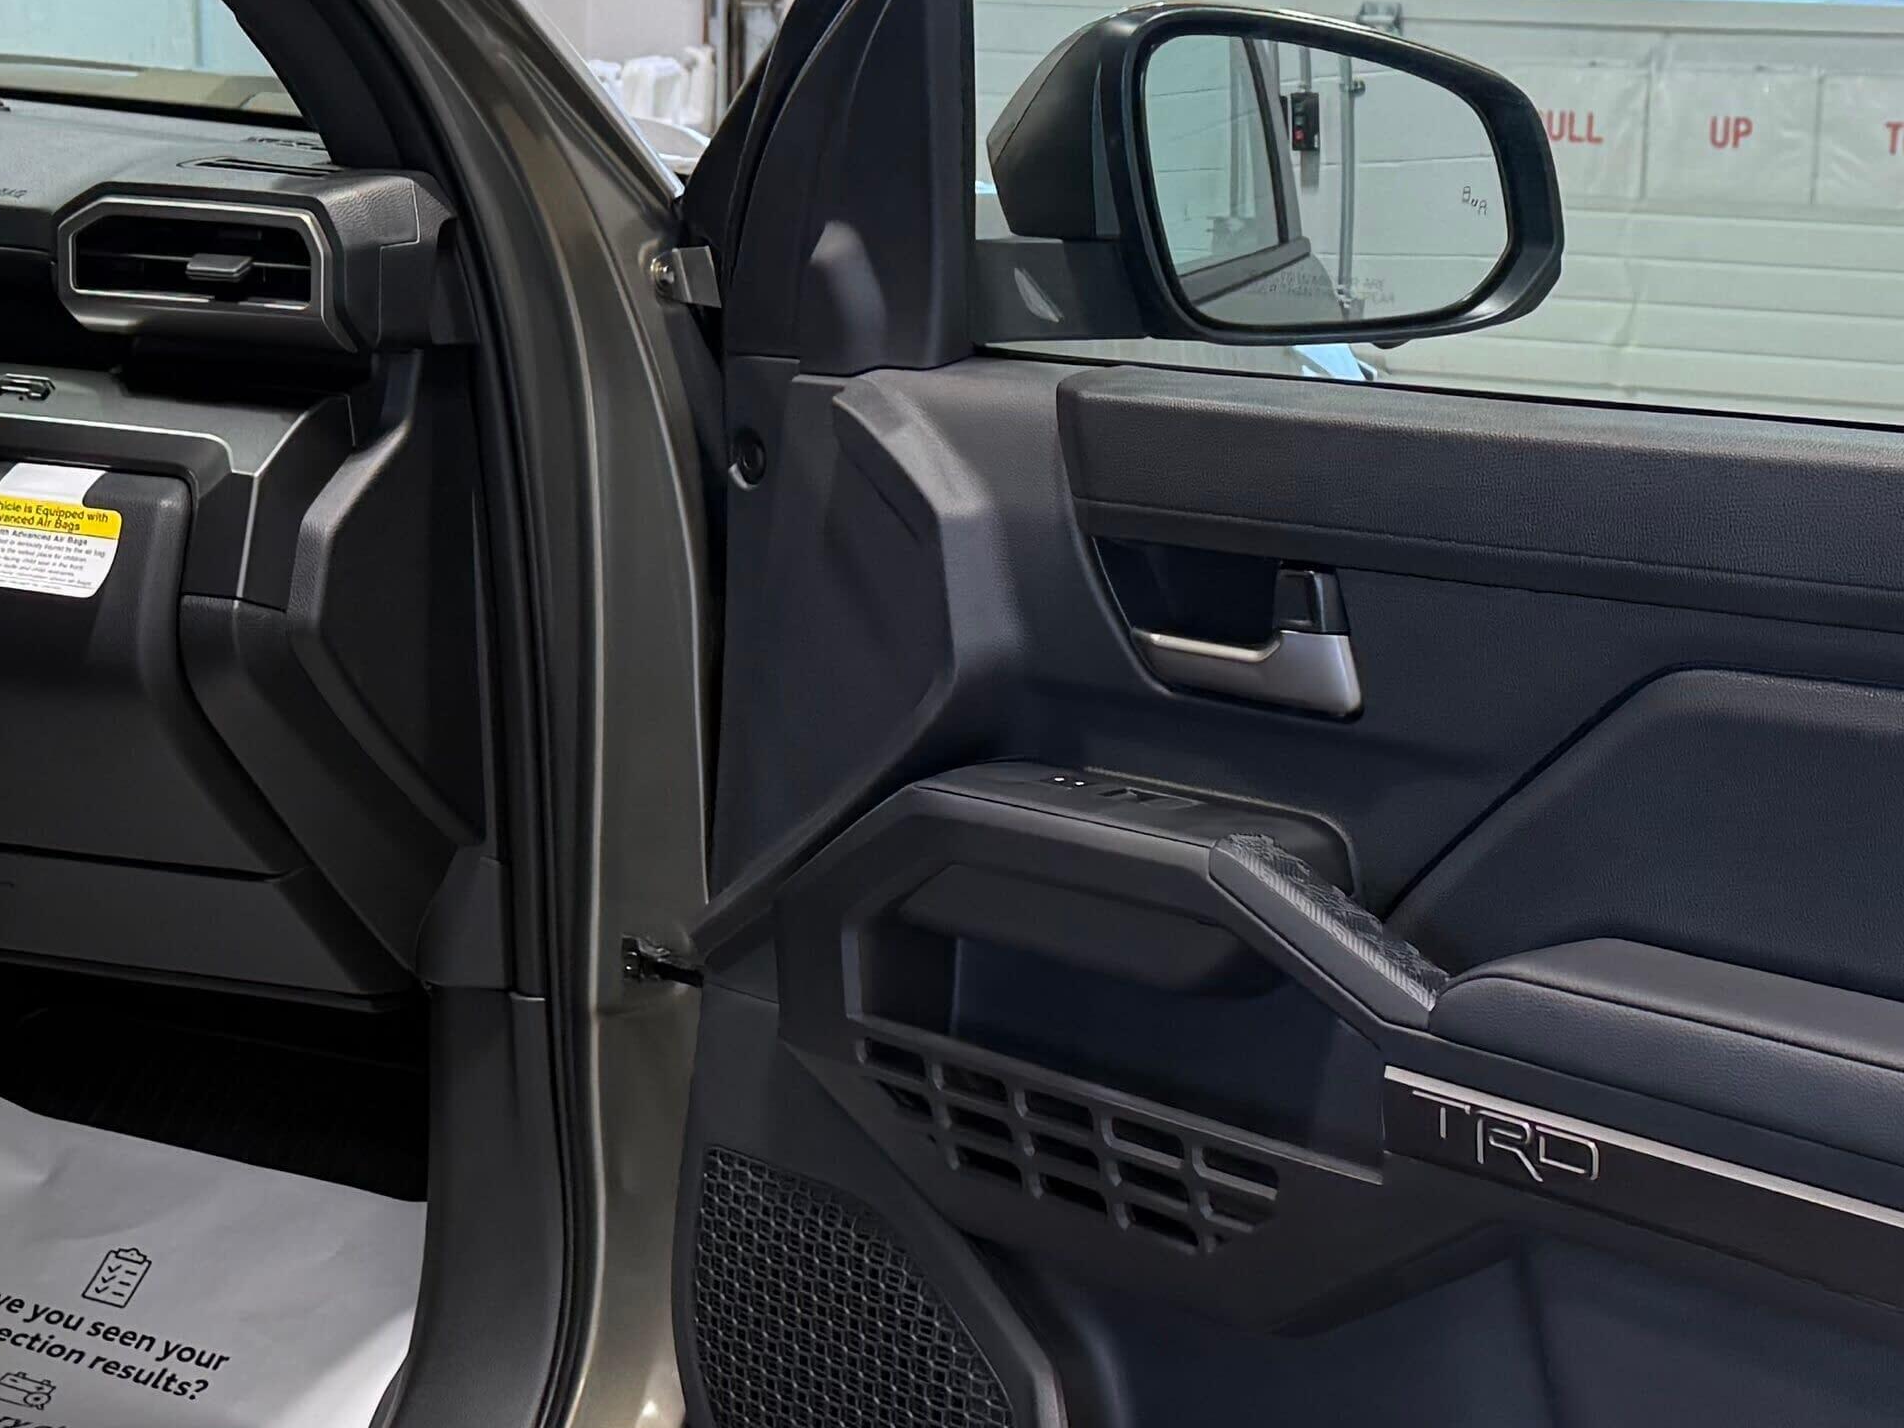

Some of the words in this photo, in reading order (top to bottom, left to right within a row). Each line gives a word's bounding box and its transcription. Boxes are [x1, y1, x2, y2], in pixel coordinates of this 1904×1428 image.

[1540, 110, 1604, 145] ULL
[1709, 115, 1753, 150] UP
[23, 504, 33, 514] is
[36, 505, 85, 521] Equipped
[87, 512, 109, 523] with
[38, 517, 53, 528] Air
[54, 519, 81, 533] Bags
[1412, 1090, 1600, 1182] TRD
[22, 1303, 85, 1332] you
[86, 1320, 156, 1353] seen
[154, 1339, 231, 1371] your
[87, 1354, 210, 1402] results?
